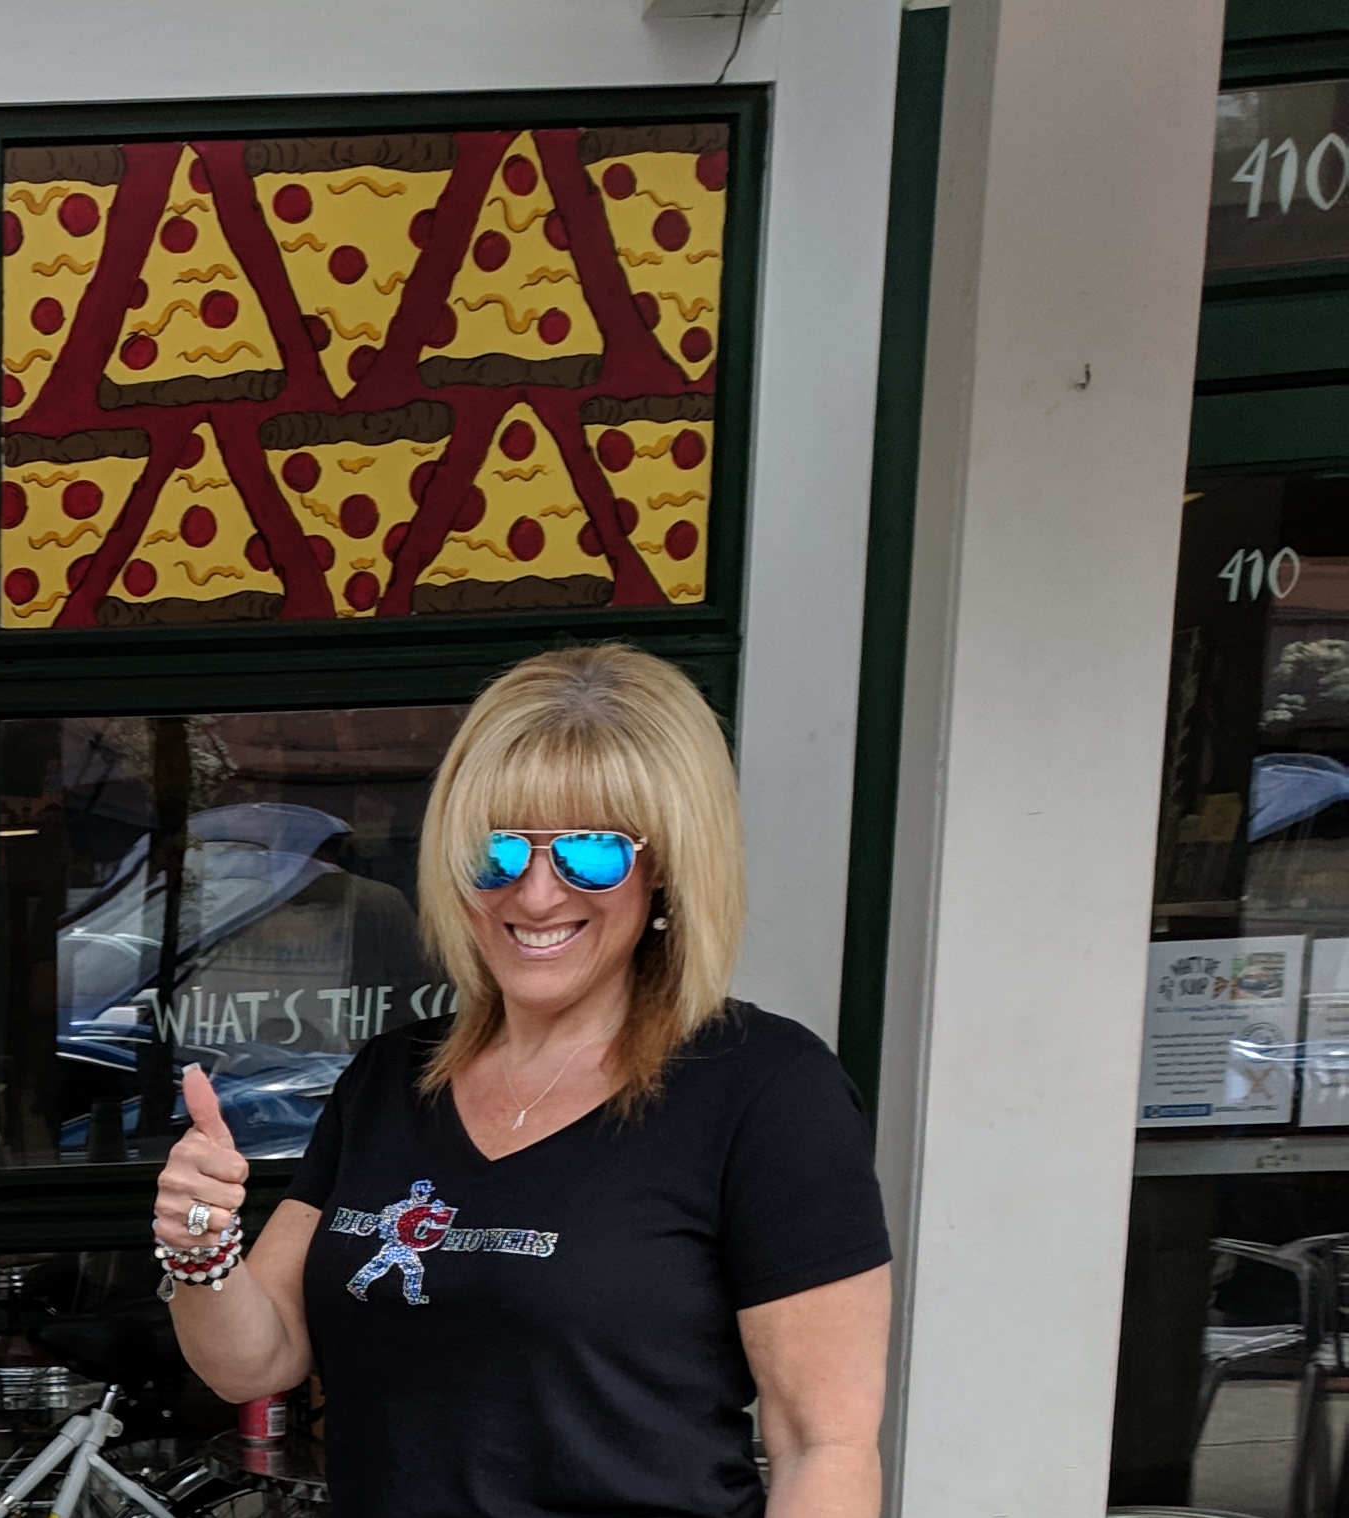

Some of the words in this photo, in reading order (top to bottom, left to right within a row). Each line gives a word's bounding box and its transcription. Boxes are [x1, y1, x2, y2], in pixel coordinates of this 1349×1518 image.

[1231, 132, 1349, 219] 410
[1217, 546, 1301, 603] 410
[132, 987, 304, 1047] WHAT'S
[317, 984, 393, 1041] THE
[328, 1206, 379, 1237] BIG
[440, 1227, 560, 1257] MOVERS
